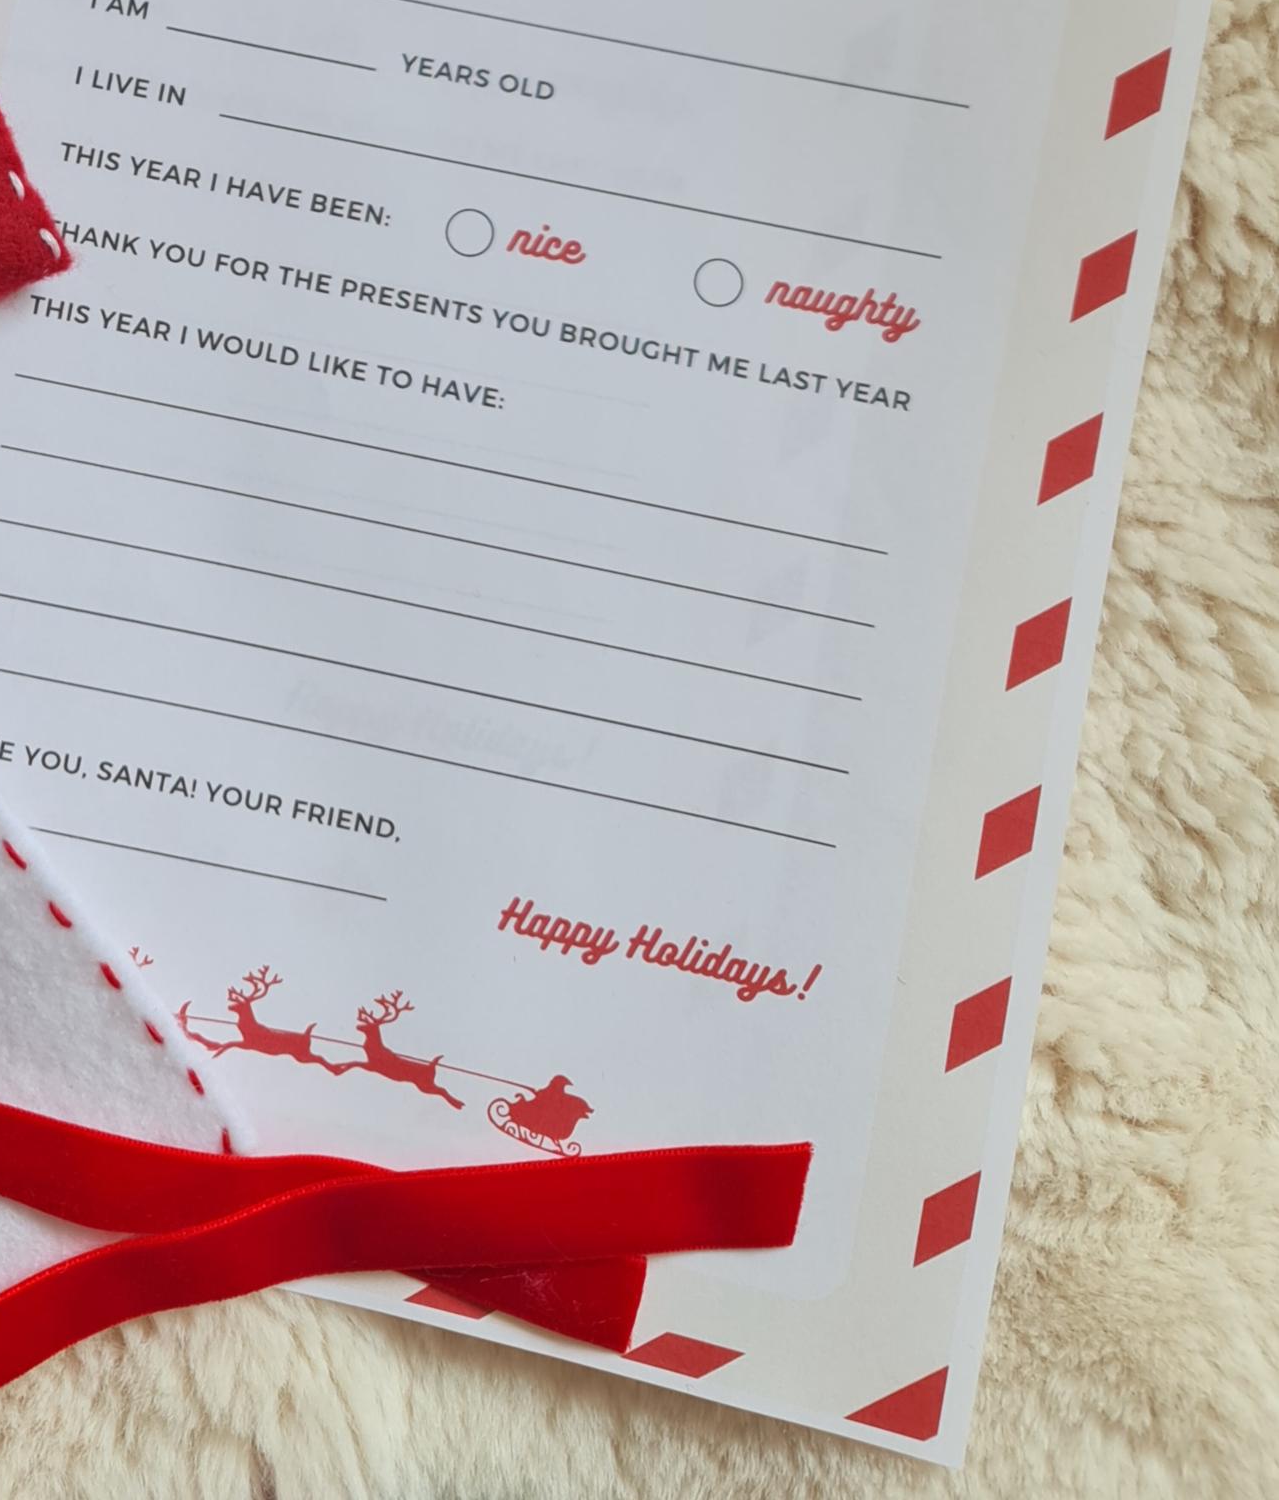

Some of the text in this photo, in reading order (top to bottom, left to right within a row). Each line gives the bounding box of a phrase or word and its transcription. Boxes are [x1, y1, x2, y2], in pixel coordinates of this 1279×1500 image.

[76, 66, 186, 106] I LIVE IN
[402, 54, 490, 87] YEARS
[499, 74, 554, 100] OLD
[61, 142, 918, 343] THIS YEAR I HAVE BEEN: nice naughty
[30, 294, 504, 409] THIS YEAR I WOULD LIKE TO HAVE:
[150, 239, 206, 267] YOU
[215, 253, 269, 281] FOR
[279, 266, 332, 294] THE
[341, 279, 483, 324] PRESENTS
[493, 309, 550, 337] YOU
[560, 323, 700, 367] BROUGHT
[708, 353, 750, 379] ME
[759, 363, 828, 393] LAST
[836, 378, 910, 411] YEAR
[26, 745, 86, 779] YOU,
[97, 761, 197, 798] SANTA!
[207, 781, 282, 816] YOUR
[292, 799, 400, 843] FRIEND,
[498, 899, 821, 1002] Happy Holidays!
